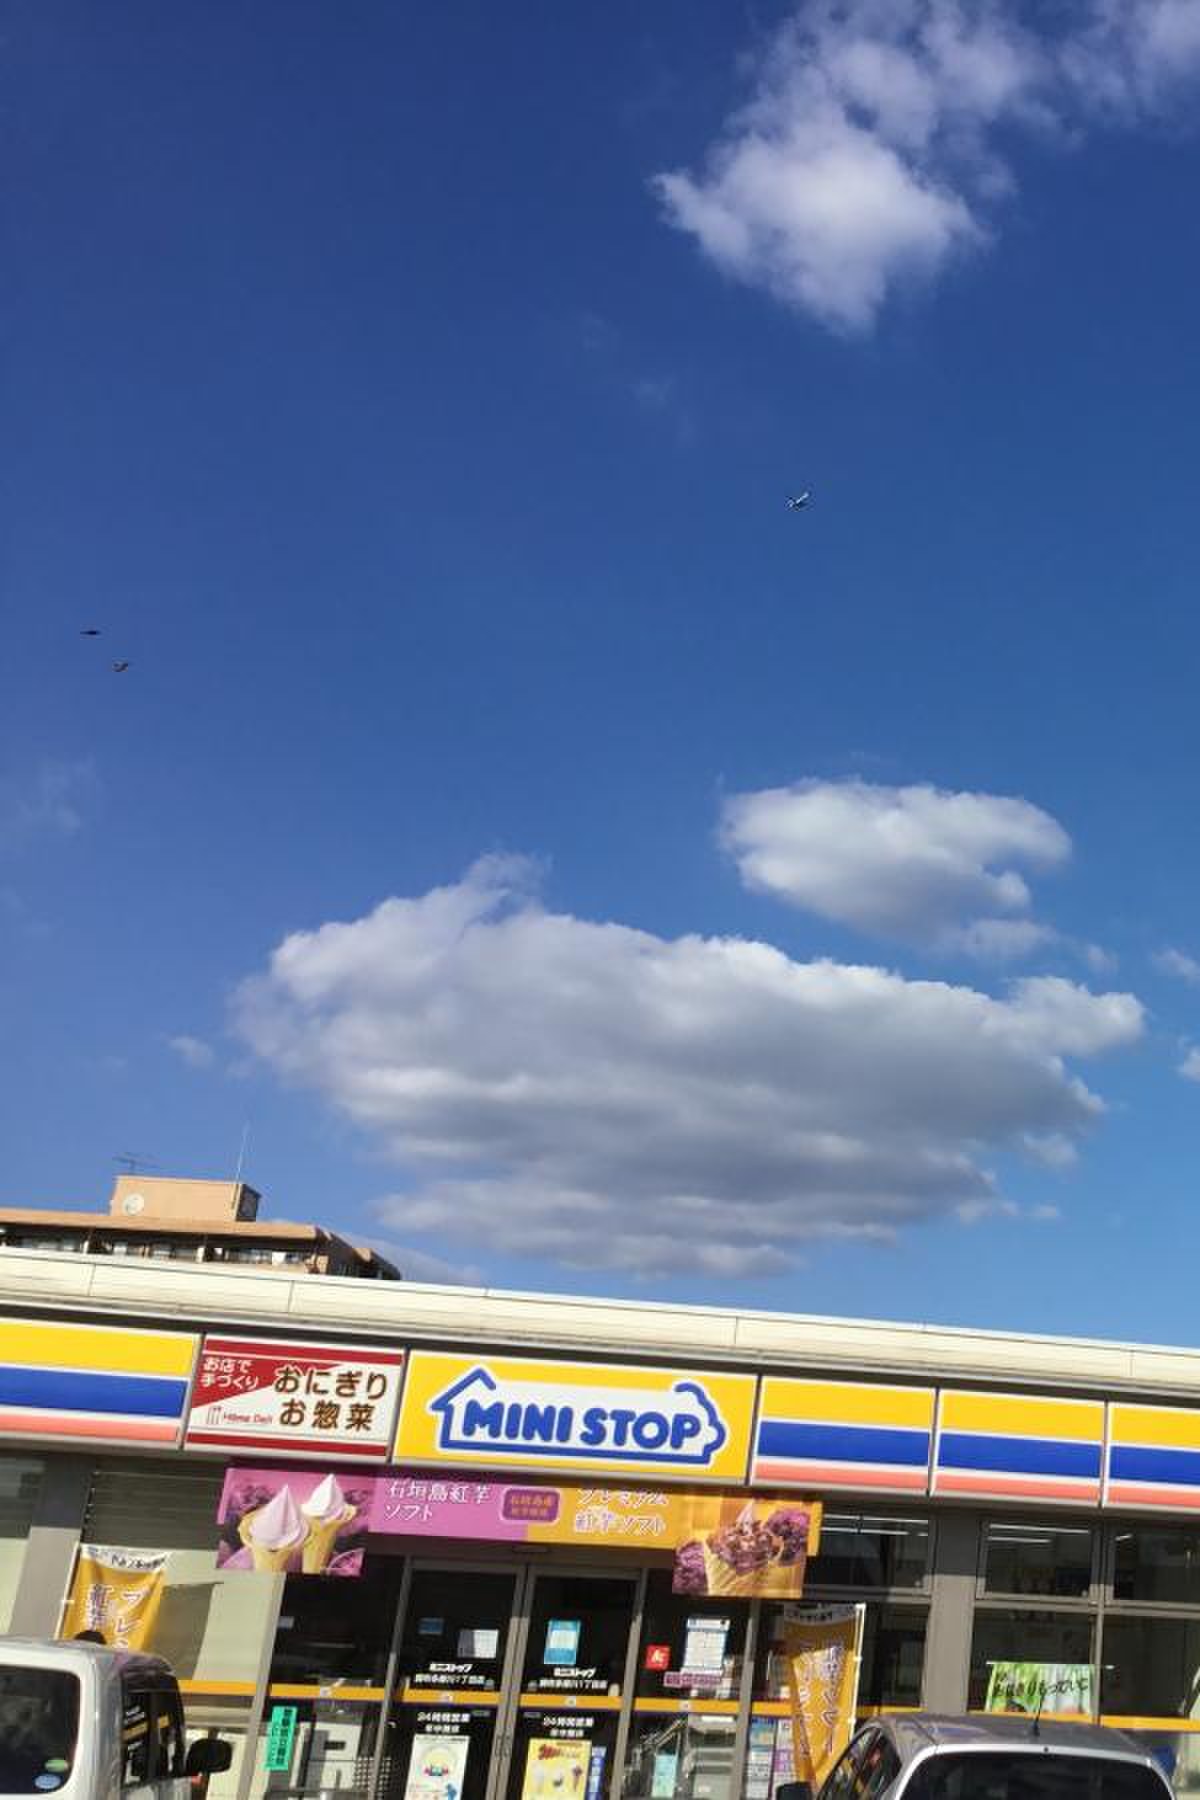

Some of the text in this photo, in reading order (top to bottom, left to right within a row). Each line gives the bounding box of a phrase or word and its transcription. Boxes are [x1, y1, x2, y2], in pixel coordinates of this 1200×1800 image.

[203, 1356, 252, 1374] お店で
[200, 1374, 259, 1391] 手づくり
[274, 1365, 388, 1400] おにぎり
[279, 1397, 376, 1432] お惣菜
[461, 1398, 702, 1451] MINI STOP
[385, 1503, 433, 1521] ソフト
